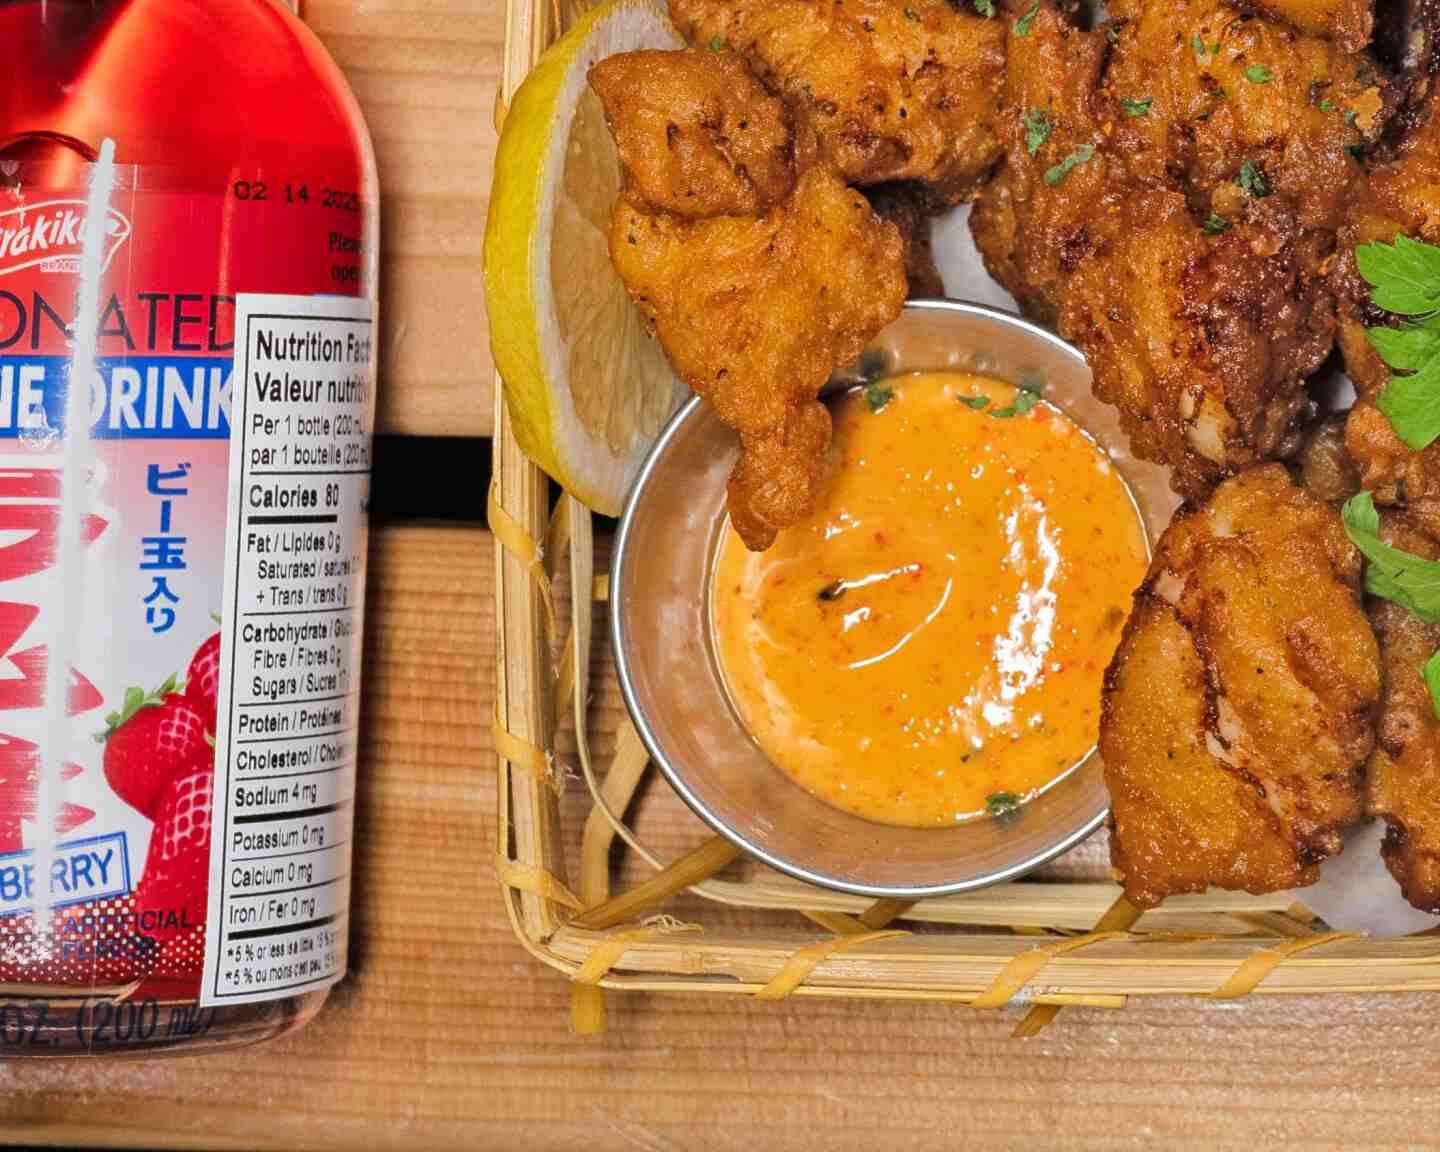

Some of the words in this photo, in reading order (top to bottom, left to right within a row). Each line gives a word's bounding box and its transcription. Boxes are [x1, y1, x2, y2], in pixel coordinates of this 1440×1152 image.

[235, 180, 267, 201] 02
[284, 183, 309, 204] 14
[256, 329, 342, 363] Nutrition
[254, 371, 322, 403] Valeur
[252, 414, 280, 435] Per
[285, 415, 291, 435] 1
[297, 415, 330, 436] bottle
[251, 447, 276, 469] par
[282, 444, 288, 465] 1
[294, 443, 341, 466] bouteille
[250, 483, 318, 508] Calories
[325, 483, 339, 506] 80
[138, 462, 192, 634] ビー玉入り
[247, 533, 271, 553] Fat
[282, 531, 325, 556] Lipides
[257, 559, 316, 579] Saturated
[270, 585, 303, 605] Trans
[313, 585, 335, 604] trans
[243, 621, 327, 645] Carbohydrate
[253, 649, 287, 669] Fibre
[298, 646, 328, 667] Fibres
[252, 675, 297, 700] Sugars
[306, 672, 336, 692] Sucres
[239, 713, 289, 734] Protein
[236, 745, 312, 770] Cholesterol
[235, 785, 289, 807] Sodium
[292, 782, 299, 800] 4
[303, 783, 317, 803] mg
[233, 827, 299, 852] Potassium
[302, 824, 308, 845] 0
[310, 825, 325, 846] mg
[231, 866, 284, 888] Calcium
[288, 862, 294, 882] 0
[298, 863, 313, 883] mg
[229, 904, 256, 925] Iron
[268, 899, 288, 920] Fer
[291, 897, 298, 916] 0
[301, 897, 315, 918] mg
[77, 999, 160, 1049] (200
